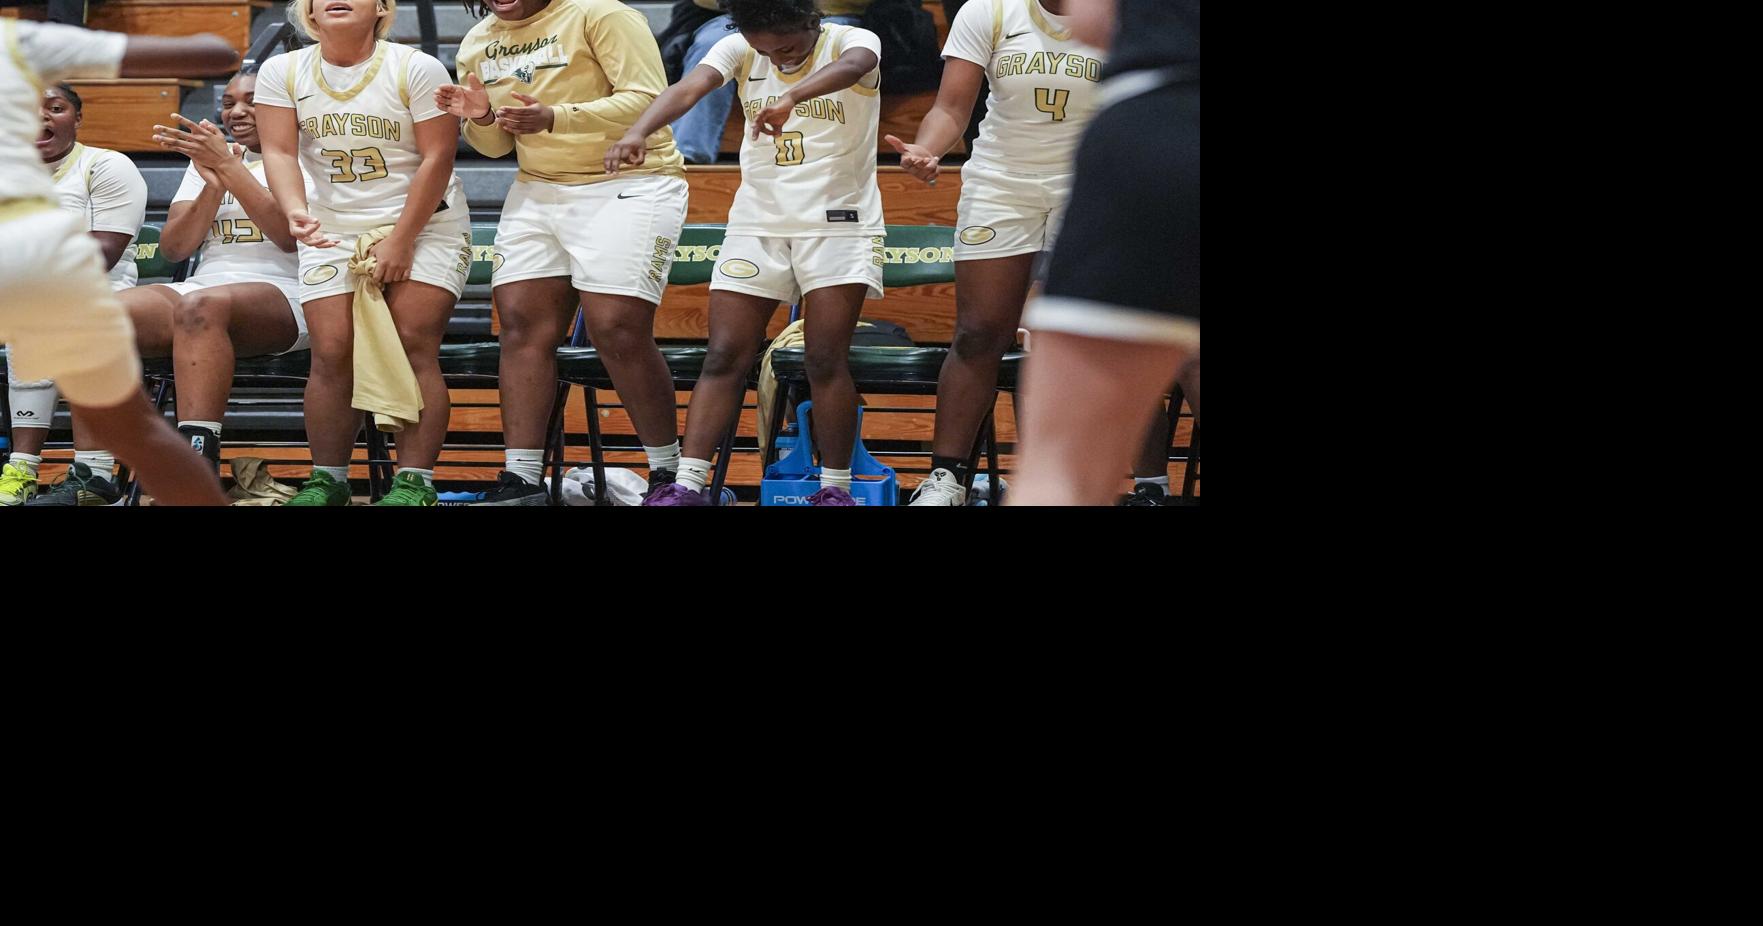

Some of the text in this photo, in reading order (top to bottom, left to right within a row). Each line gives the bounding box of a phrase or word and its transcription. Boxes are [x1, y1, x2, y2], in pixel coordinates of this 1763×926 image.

[996, 51, 1103, 82] GRAYSO
[744, 96, 846, 124] GRSON
[1034, 87, 1070, 121] 4
[774, 131, 805, 166] 0
[321, 147, 388, 183] 33
[648, 236, 671, 282] RAMS
[672, 245, 721, 262] AYSO
[882, 246, 955, 264] AYSON
